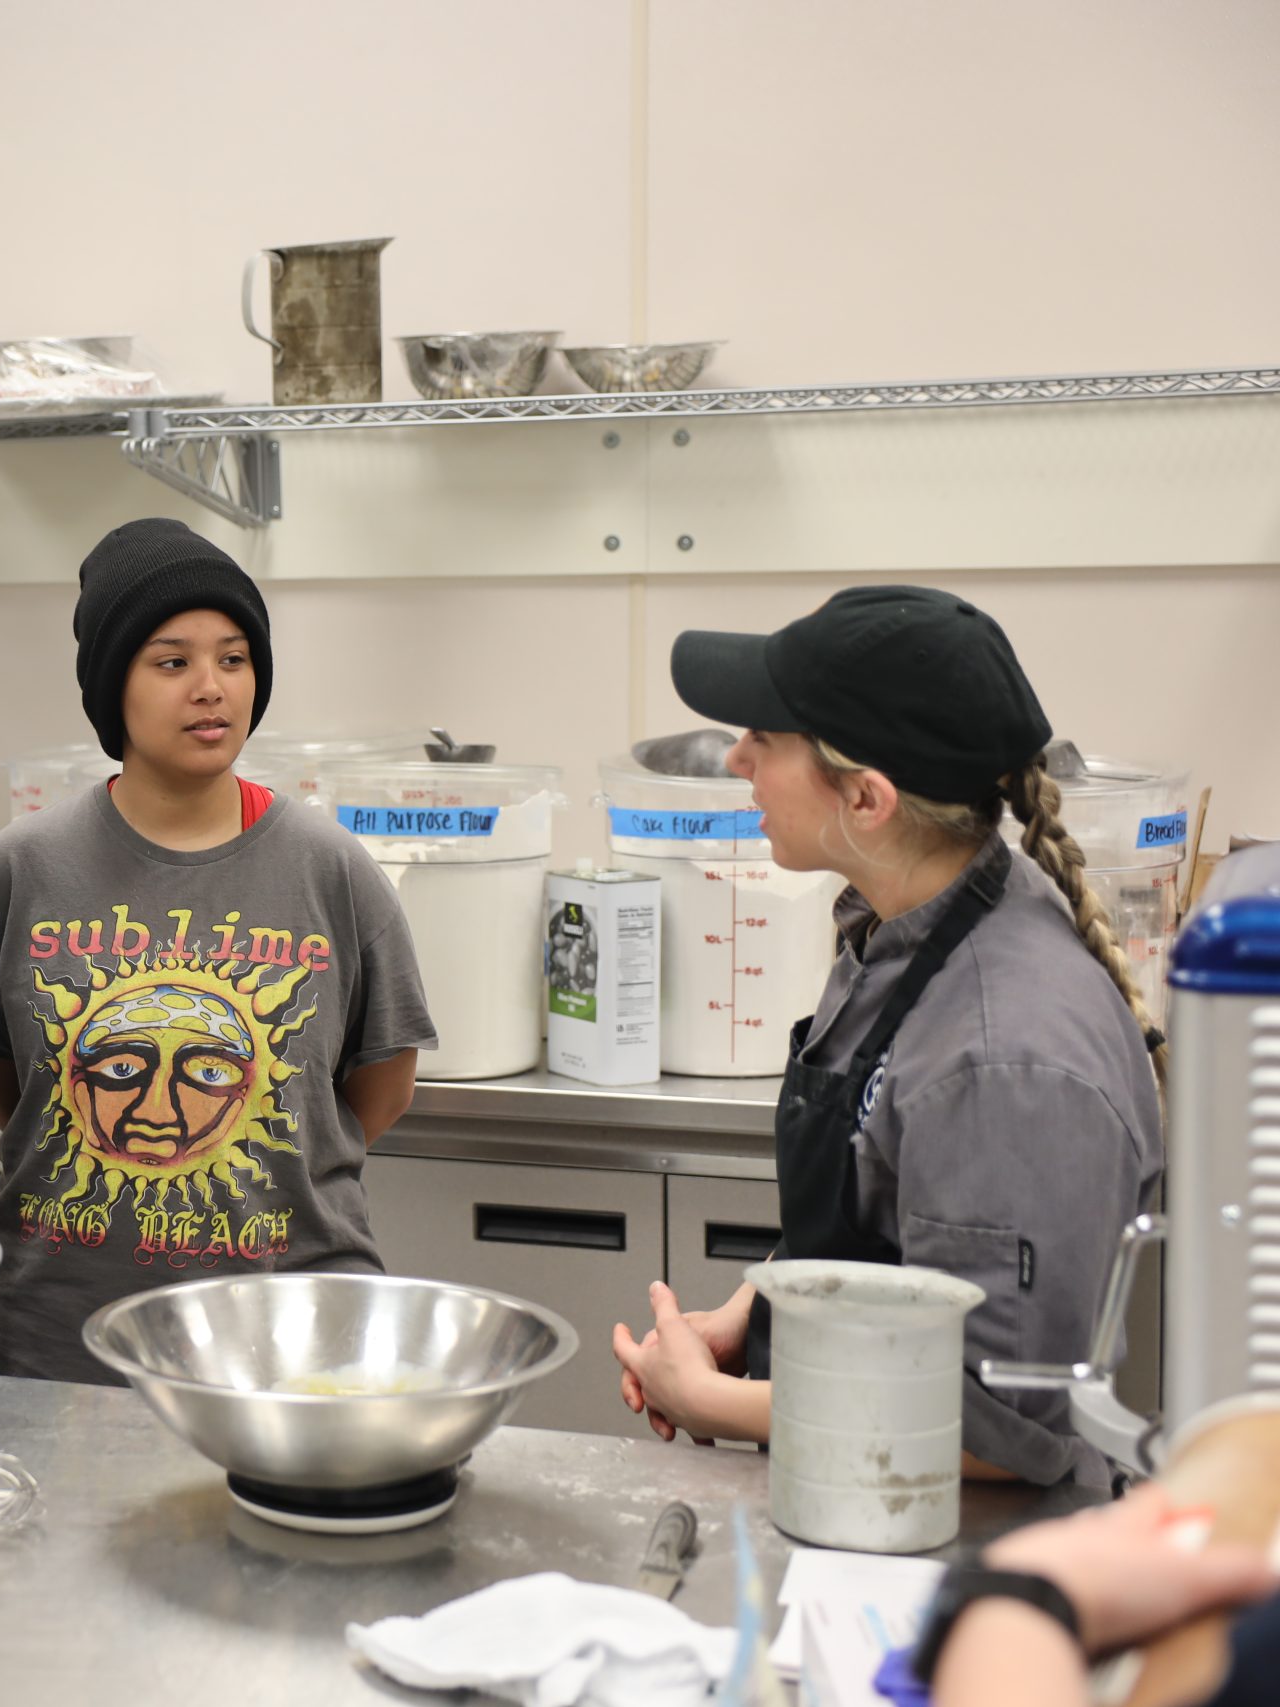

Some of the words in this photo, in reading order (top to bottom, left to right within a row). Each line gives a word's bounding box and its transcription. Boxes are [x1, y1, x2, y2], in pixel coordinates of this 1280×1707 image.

[353, 809, 377, 834] All
[1145, 821, 1175, 843] Bread
[29, 904, 331, 972] sublime
[19, 1193, 109, 1255] LONG
[133, 1206, 294, 1269] BEACH
